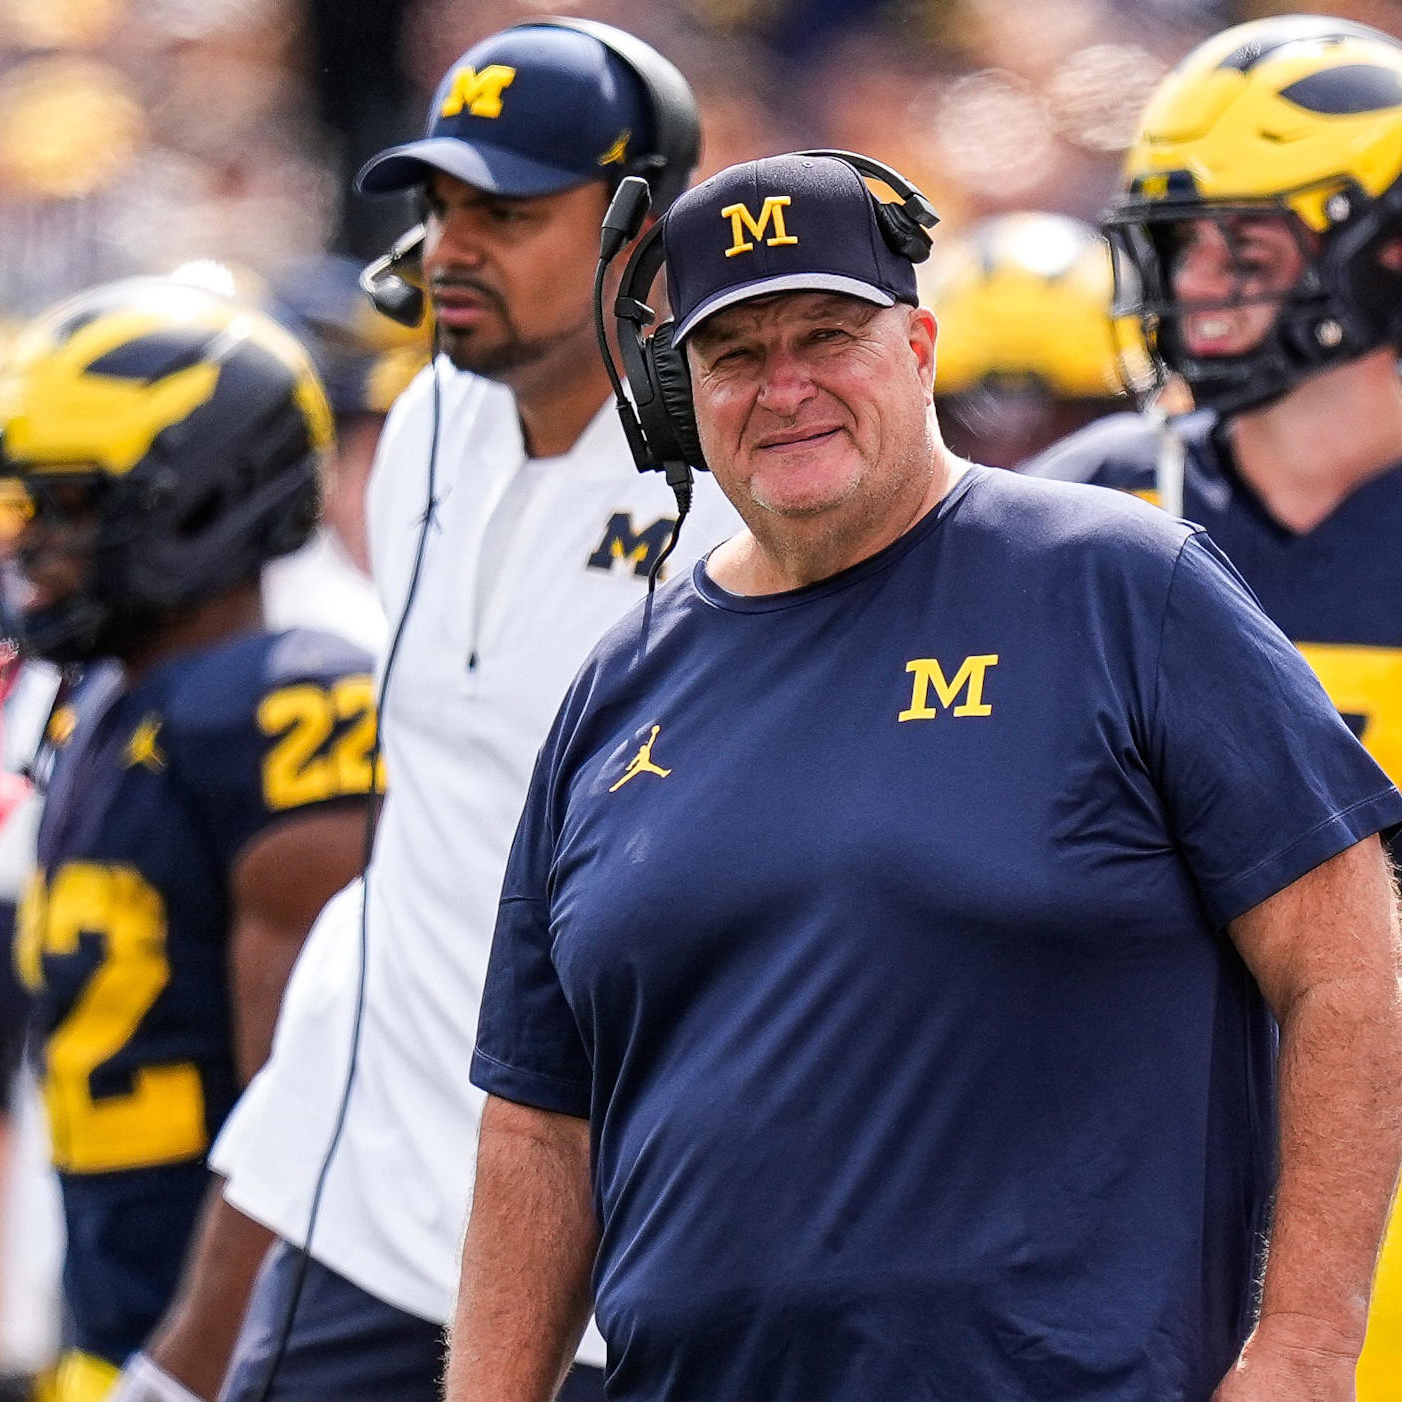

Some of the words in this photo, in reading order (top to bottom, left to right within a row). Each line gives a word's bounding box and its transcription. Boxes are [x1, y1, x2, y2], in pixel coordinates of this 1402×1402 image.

[440, 65, 517, 118] M
[721, 195, 799, 258] M
[587, 512, 678, 580] M
[898, 654, 999, 722] M
[255, 674, 388, 811] 22
[13, 860, 211, 1175] 2
